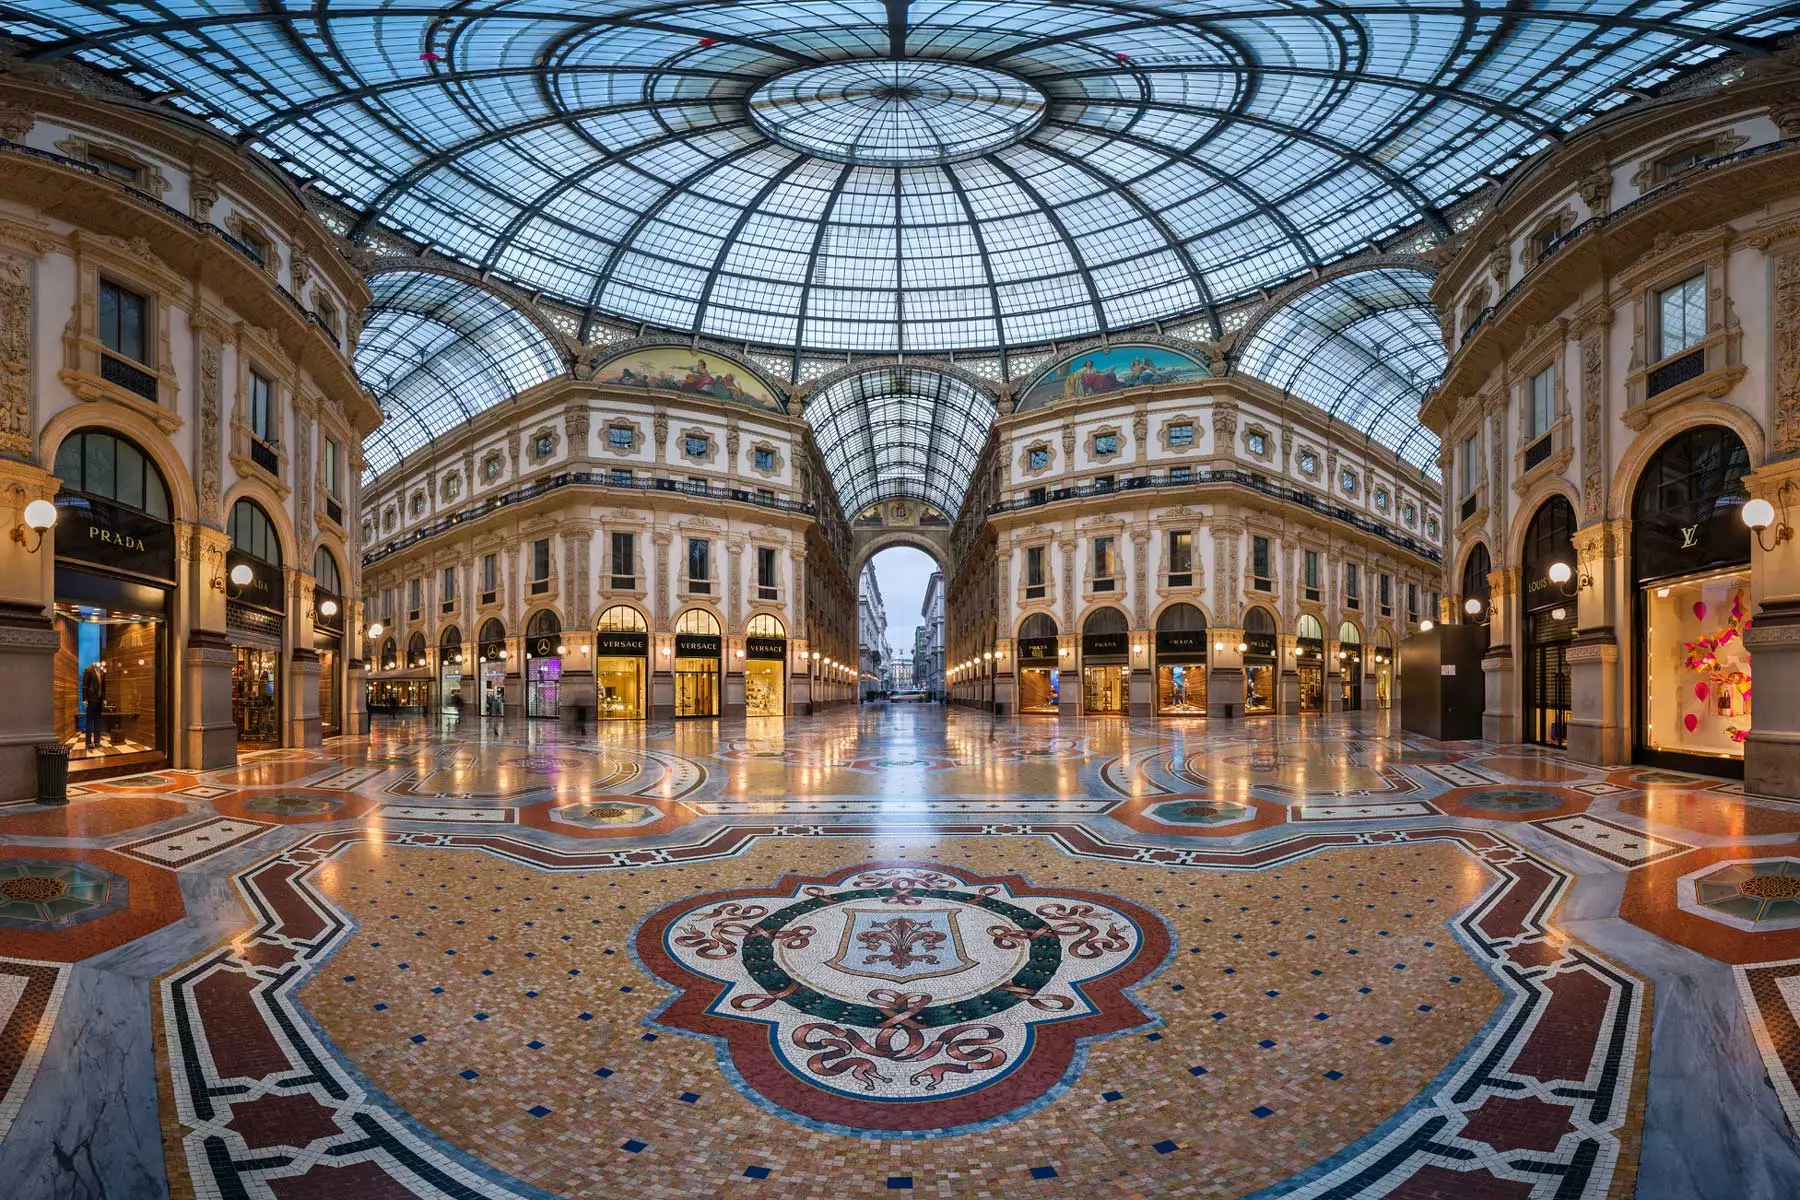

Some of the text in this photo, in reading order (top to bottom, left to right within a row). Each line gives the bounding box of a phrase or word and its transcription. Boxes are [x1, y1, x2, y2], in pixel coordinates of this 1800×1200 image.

[89, 526, 145, 552] PRADA
[1528, 577, 1547, 593] LOUIS
[603, 640, 644, 648] VERSACE
[680, 642, 717, 650] VERSACE
[750, 645, 783, 653] VERSACE
